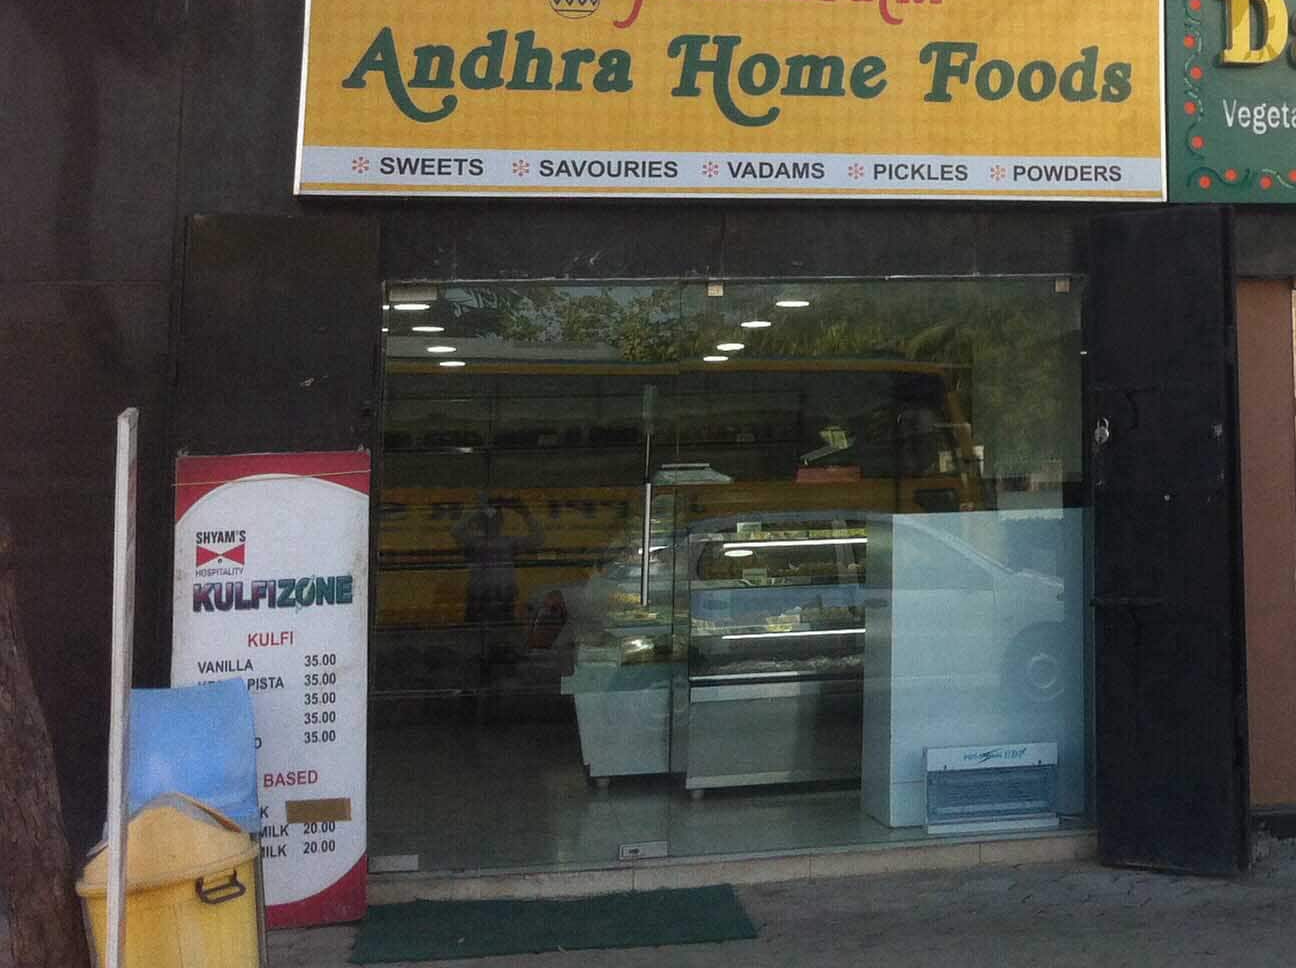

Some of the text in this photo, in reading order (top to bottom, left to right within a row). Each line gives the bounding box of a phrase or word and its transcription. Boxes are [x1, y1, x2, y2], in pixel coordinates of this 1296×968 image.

[341, 27, 1132, 127] Andhra Home Foods
[380, 156, 1122, 182] SWEETS SAVOURIES VADAMS PICKLES POWDERS
[196, 530, 246, 544] SHYAM'S
[195, 567, 244, 577] HOSPITALITY
[193, 575, 353, 612] KULFIZONE
[247, 632, 294, 647] KULFI
[197, 654, 336, 674] VANILLA 35.00
[247, 672, 336, 690] PISTA 35.00
[304, 692, 336, 705] 35.00
[304, 711, 336, 724] 35.00
[304, 730, 336, 744] 35.00
[264, 770, 318, 787] BASED
[303, 820, 336, 834] 20.00
[303, 840, 336, 854] 20.00
